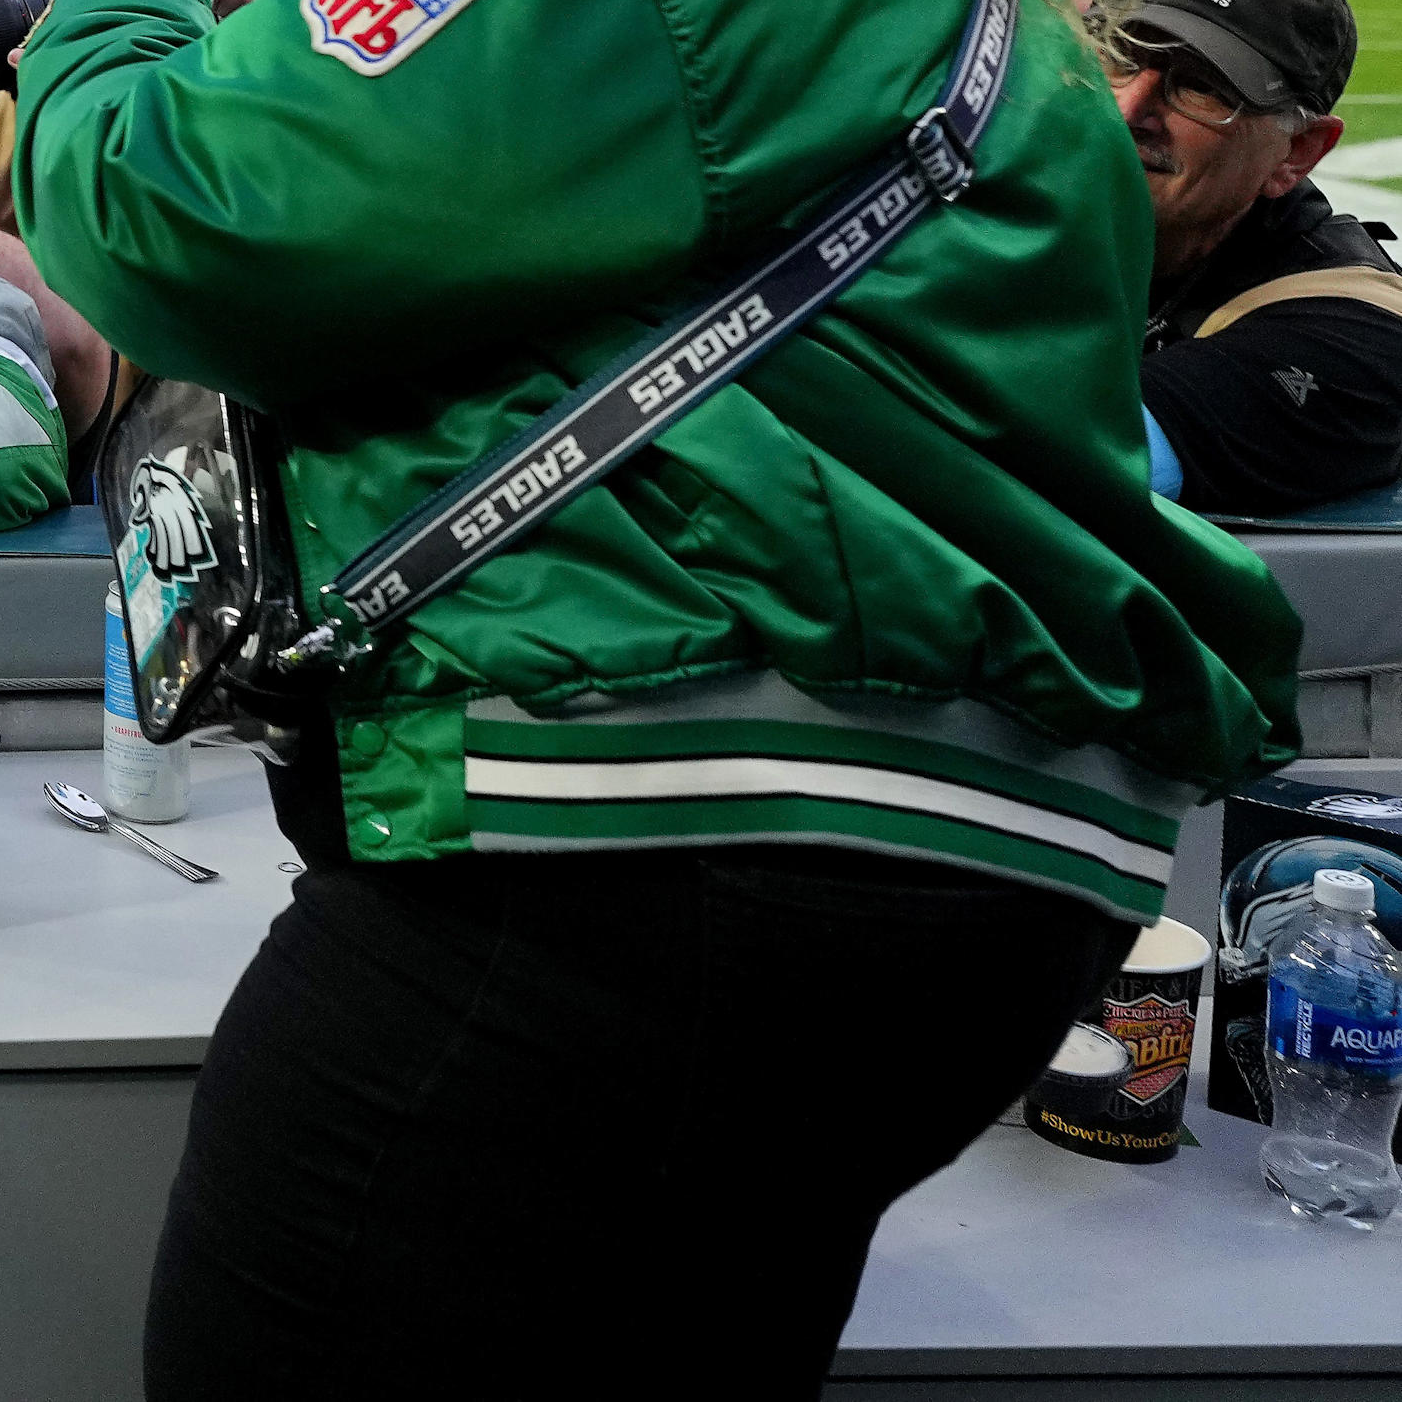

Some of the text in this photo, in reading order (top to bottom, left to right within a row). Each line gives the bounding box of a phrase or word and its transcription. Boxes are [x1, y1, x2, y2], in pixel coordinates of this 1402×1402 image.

[627, 294, 774, 414] EAGLES
[449, 435, 587, 550] EAGLES
[115, 726, 144, 739] GRAPEFRU
